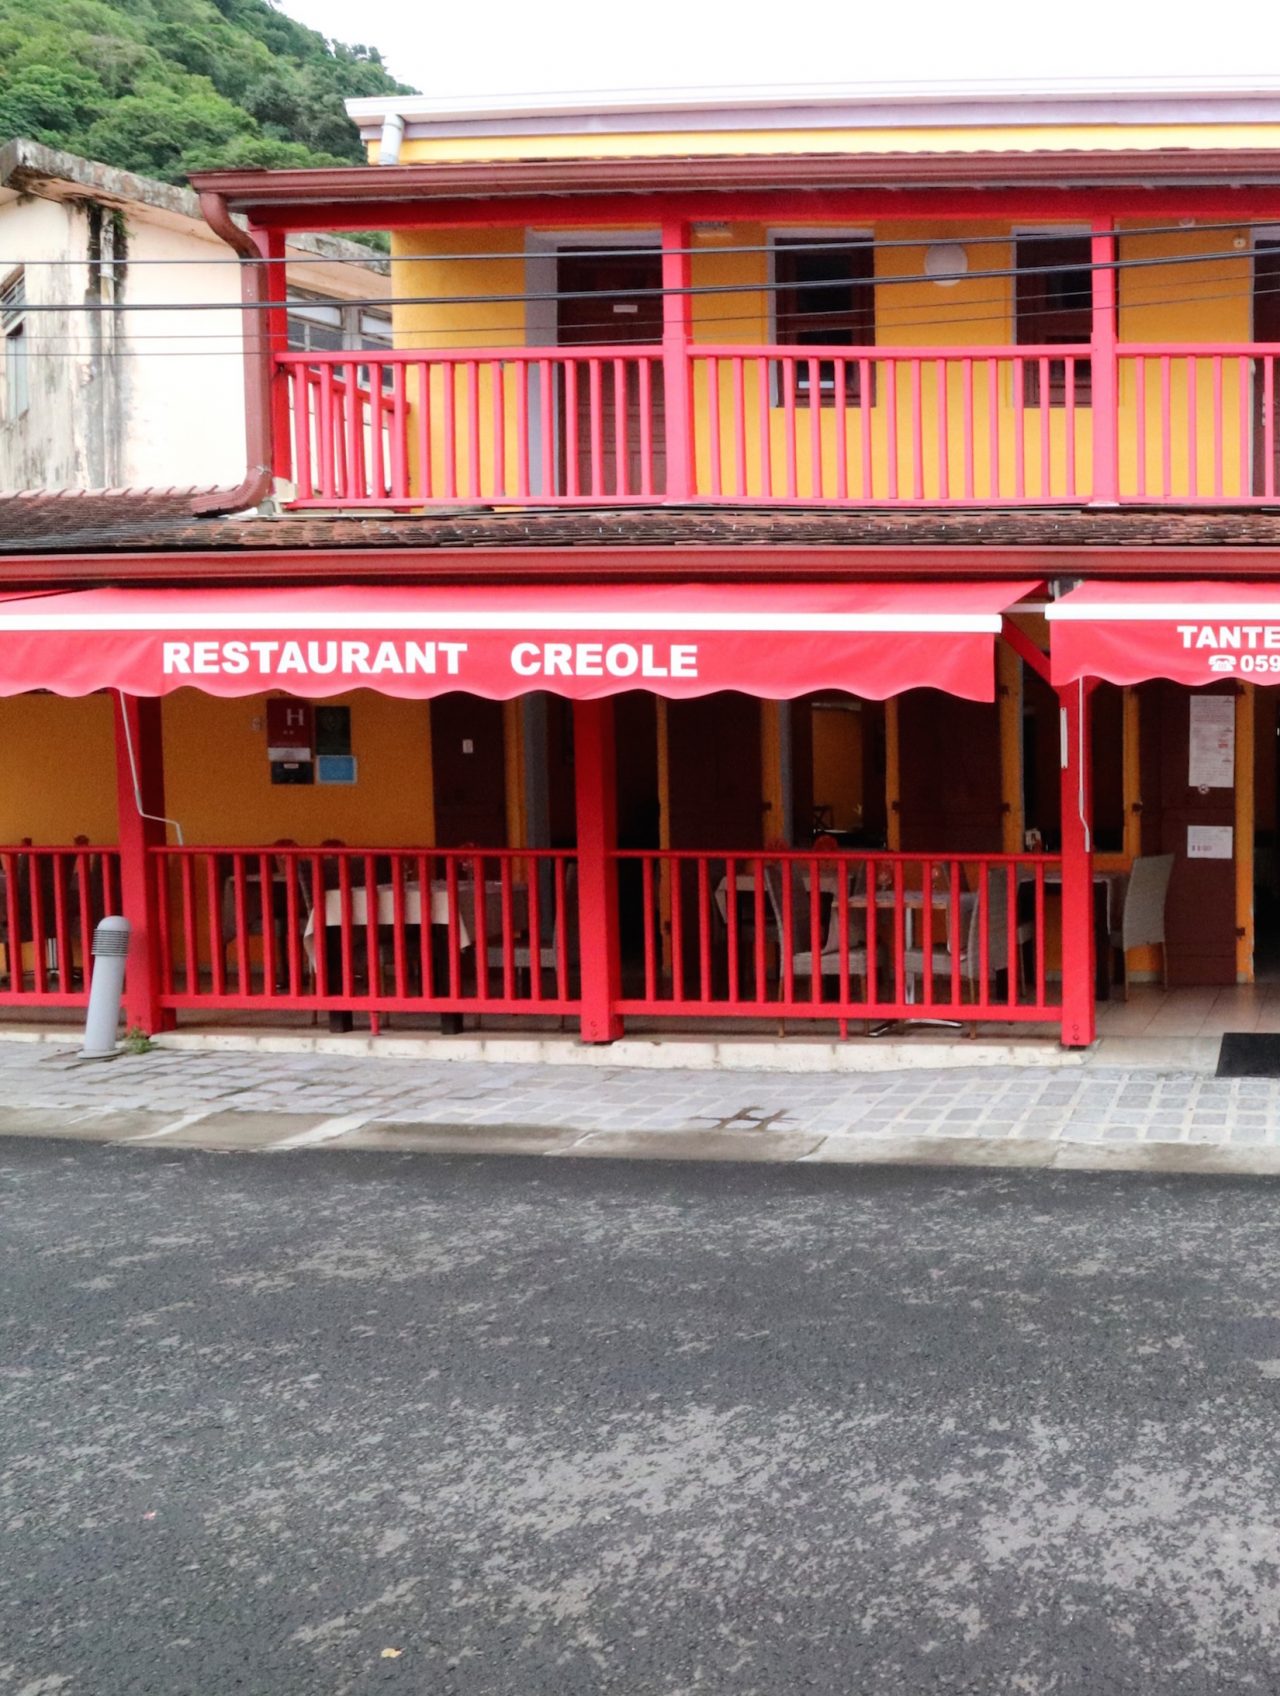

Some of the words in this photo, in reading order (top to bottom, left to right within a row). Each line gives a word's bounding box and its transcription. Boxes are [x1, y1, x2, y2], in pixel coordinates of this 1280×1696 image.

[163, 641, 468, 675] RESTAURANT
[510, 643, 698, 678] CREOLE
[287, 708, 304, 726] H
